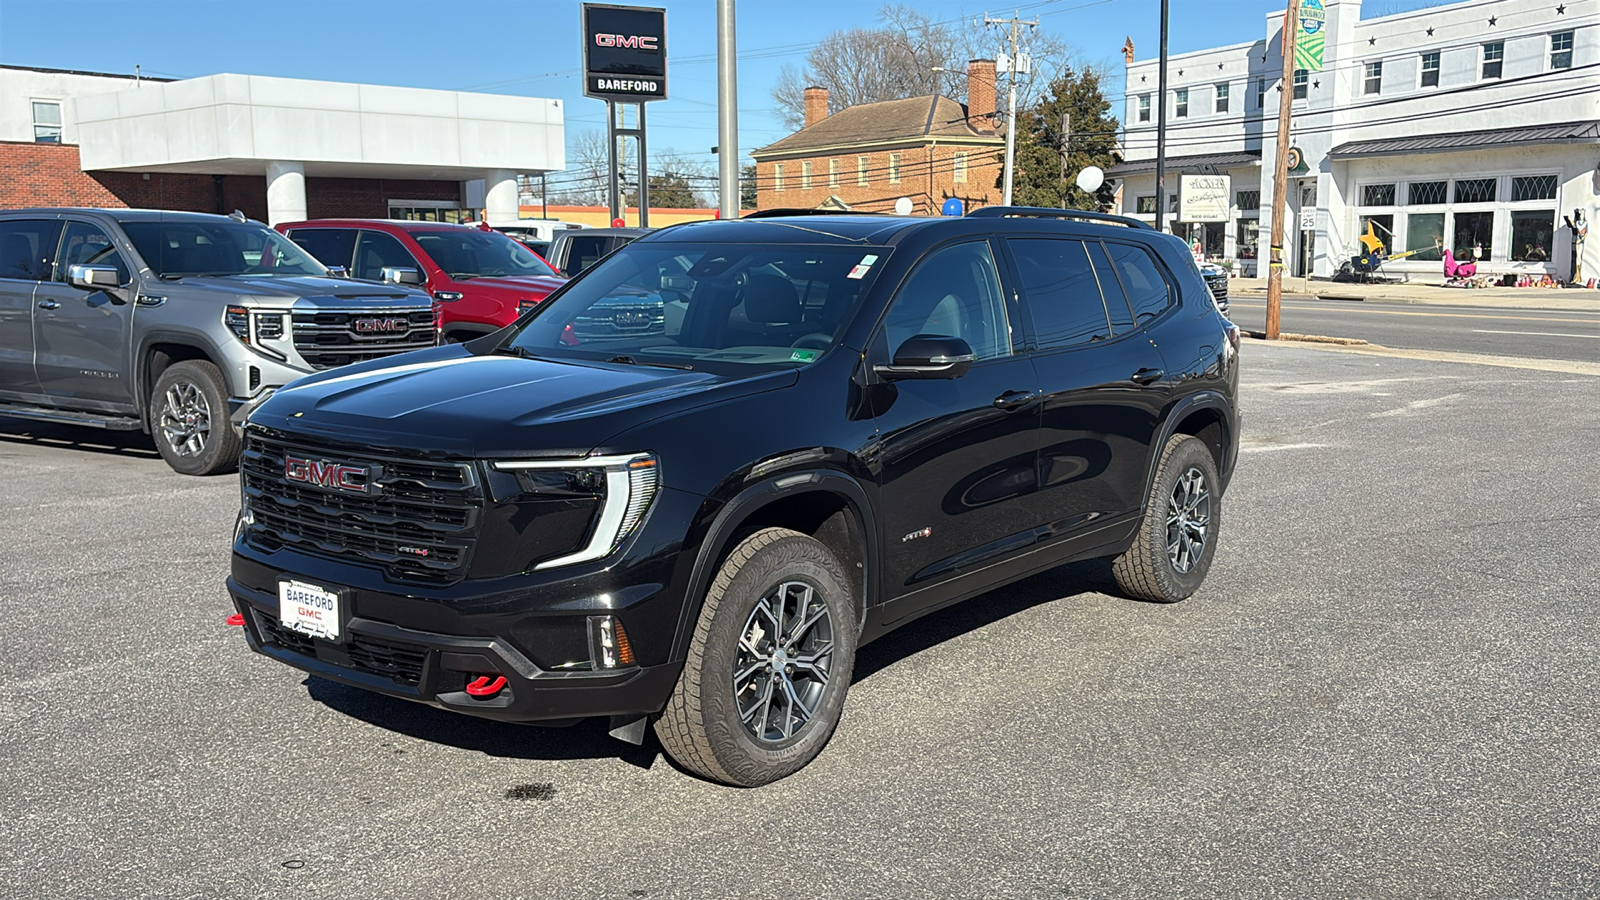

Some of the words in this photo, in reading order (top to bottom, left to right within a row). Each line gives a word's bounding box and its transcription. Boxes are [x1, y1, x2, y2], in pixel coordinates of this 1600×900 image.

[595, 33, 658, 50] GMC
[597, 79, 657, 92] BAREFORD
[1302, 218, 1315, 227] 25
[356, 318, 408, 331] GMC
[285, 455, 368, 493] GMC
[286, 588, 334, 611] BAREFORD
[297, 606, 323, 621] GMC
